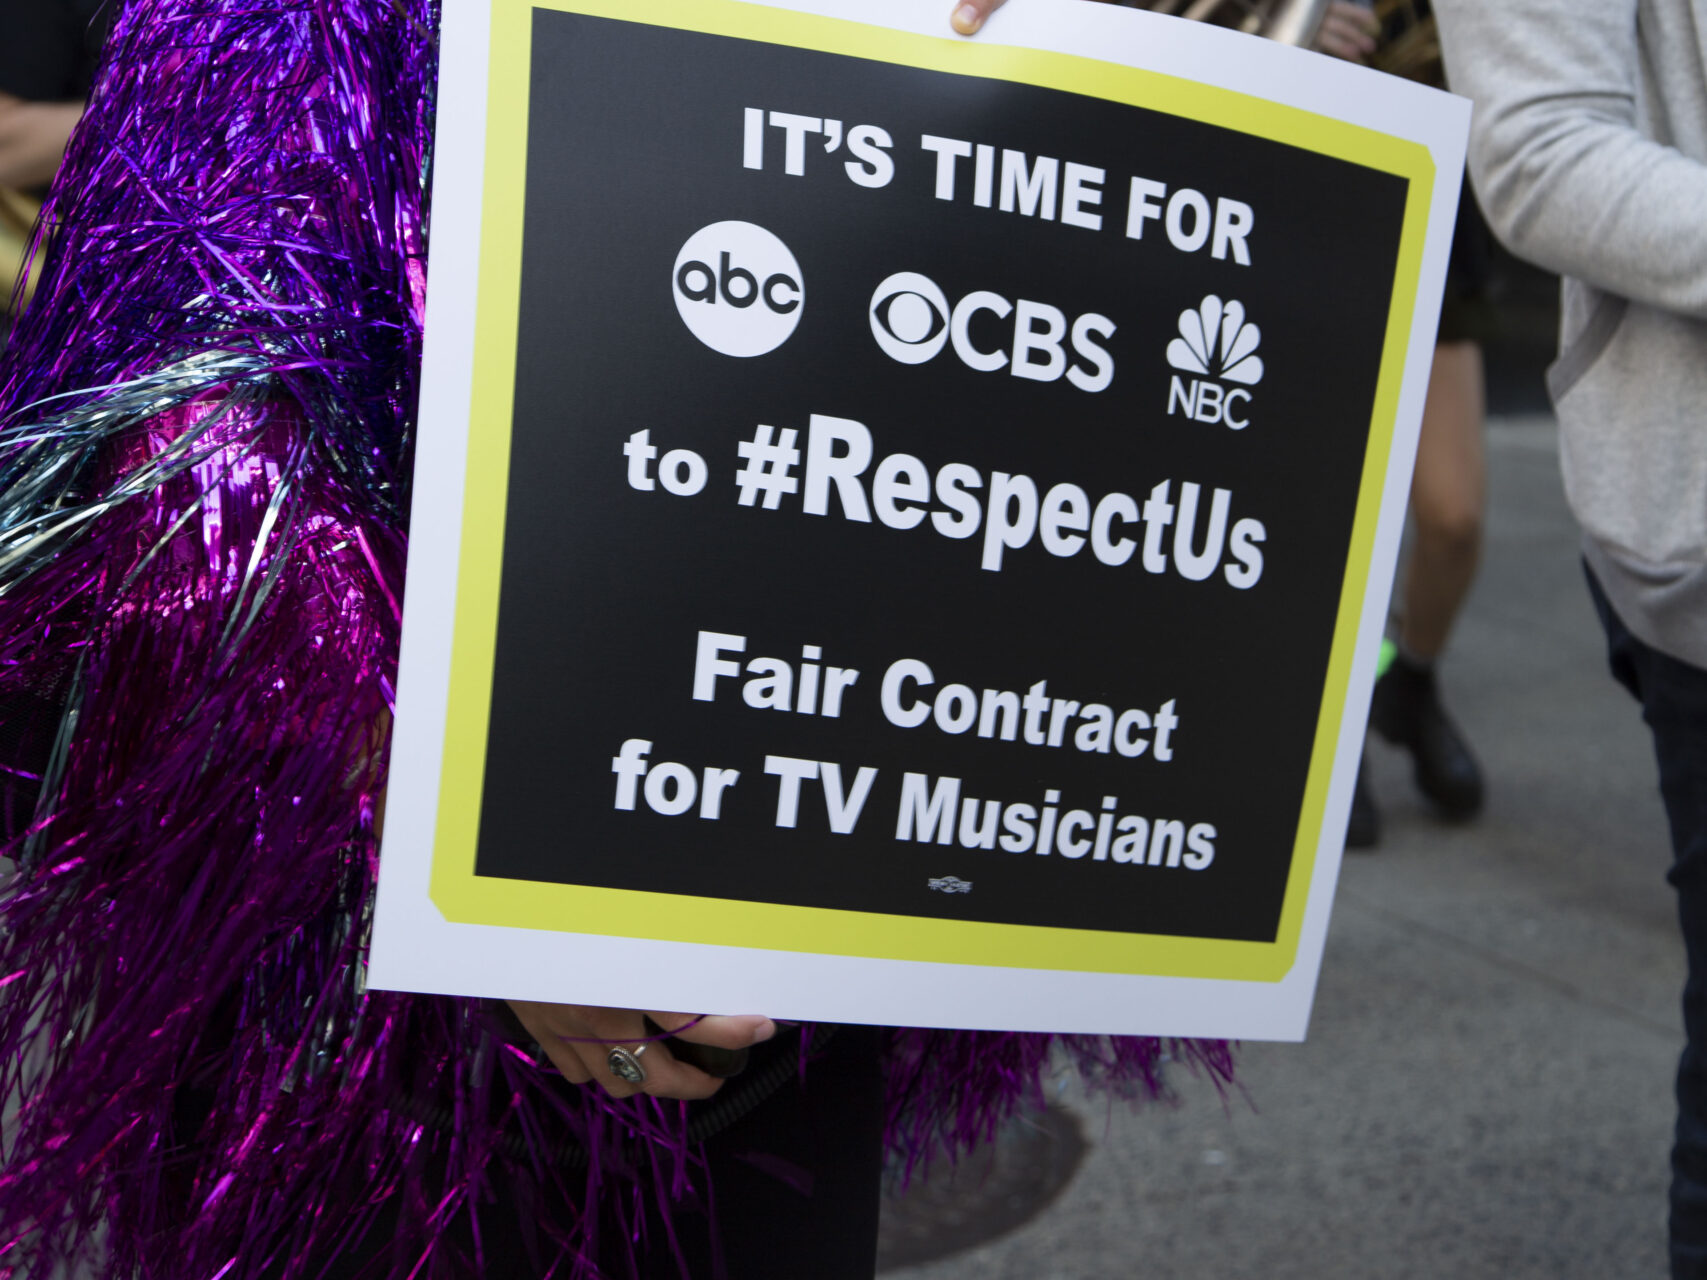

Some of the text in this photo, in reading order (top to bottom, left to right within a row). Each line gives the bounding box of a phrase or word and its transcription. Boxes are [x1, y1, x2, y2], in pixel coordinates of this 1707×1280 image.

[921, 135, 1105, 230] TIME
[1126, 177, 1253, 265] FOR
[676, 251, 1252, 430] abc CBS NBC
[624, 414, 1266, 588] to #RespectUs
[693, 631, 1178, 761] Fair Contract
[612, 738, 1216, 870] for TV Musicians
